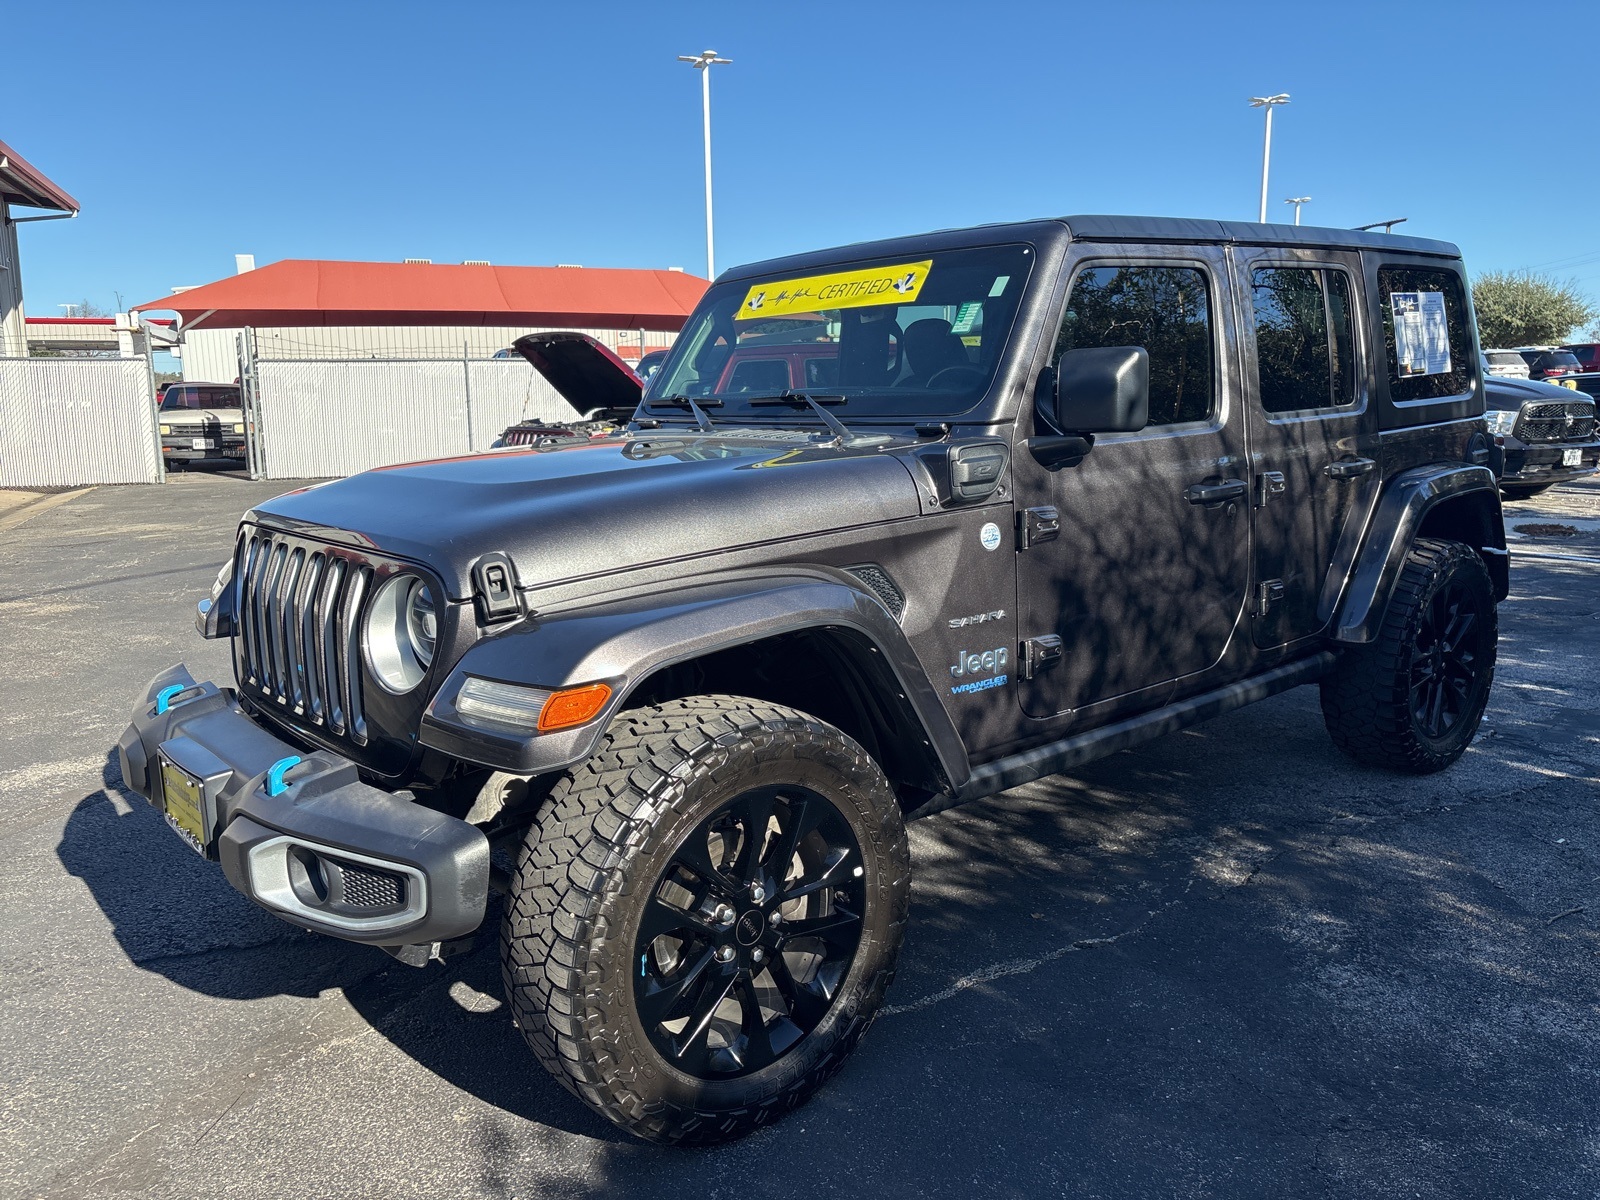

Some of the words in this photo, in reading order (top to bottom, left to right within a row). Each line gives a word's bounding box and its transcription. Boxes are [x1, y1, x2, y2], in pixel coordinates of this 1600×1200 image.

[818, 278, 893, 300] CERTIFIED
[949, 610, 1006, 629] SAHARA
[950, 647, 1008, 678] Jeep
[951, 674, 1008, 694] WRANGLER
